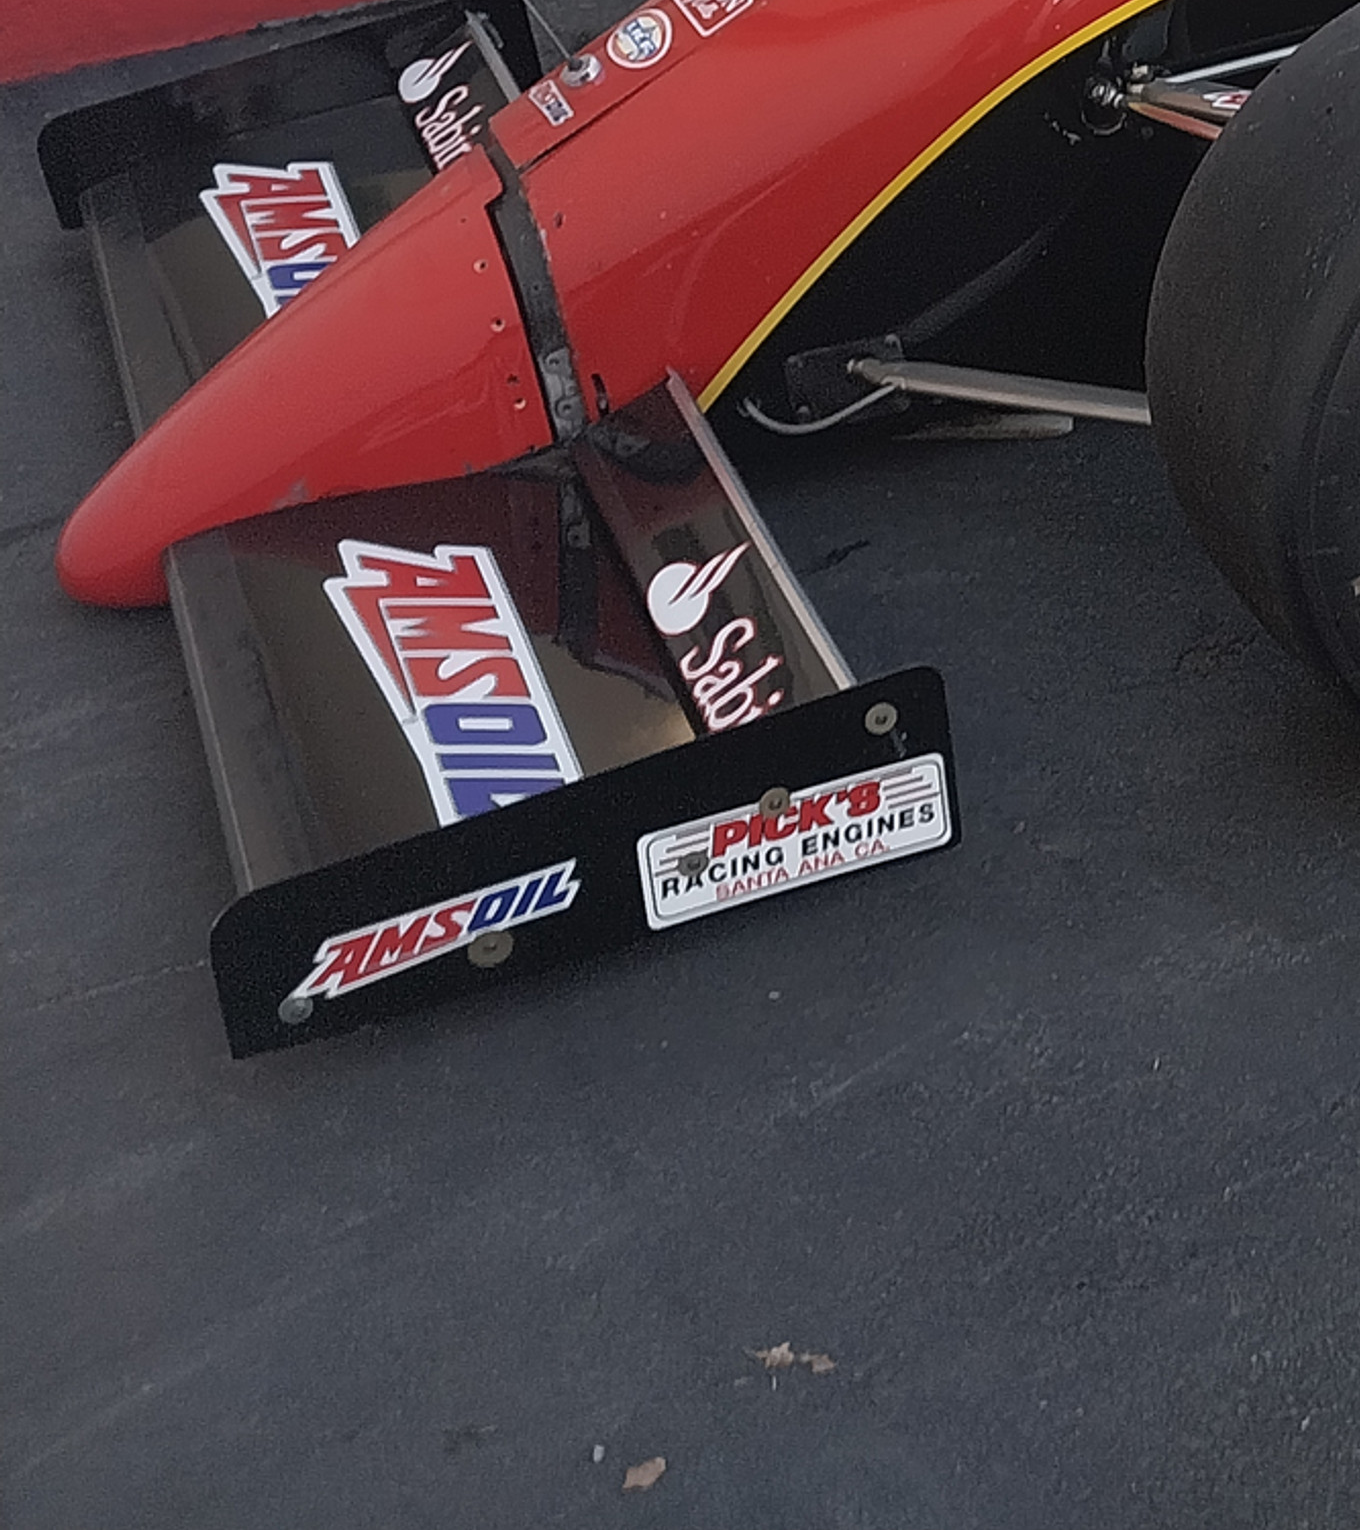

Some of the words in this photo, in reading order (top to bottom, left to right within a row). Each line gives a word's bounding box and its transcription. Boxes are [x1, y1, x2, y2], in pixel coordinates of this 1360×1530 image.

[660, 846, 785, 901] RACING
[801, 802, 936, 857] ENGINES
[711, 781, 882, 858] PICK'S
[715, 867, 790, 902] SANTA
[798, 850, 846, 876] ANA
[308, 869, 578, 992] AMSOIL
